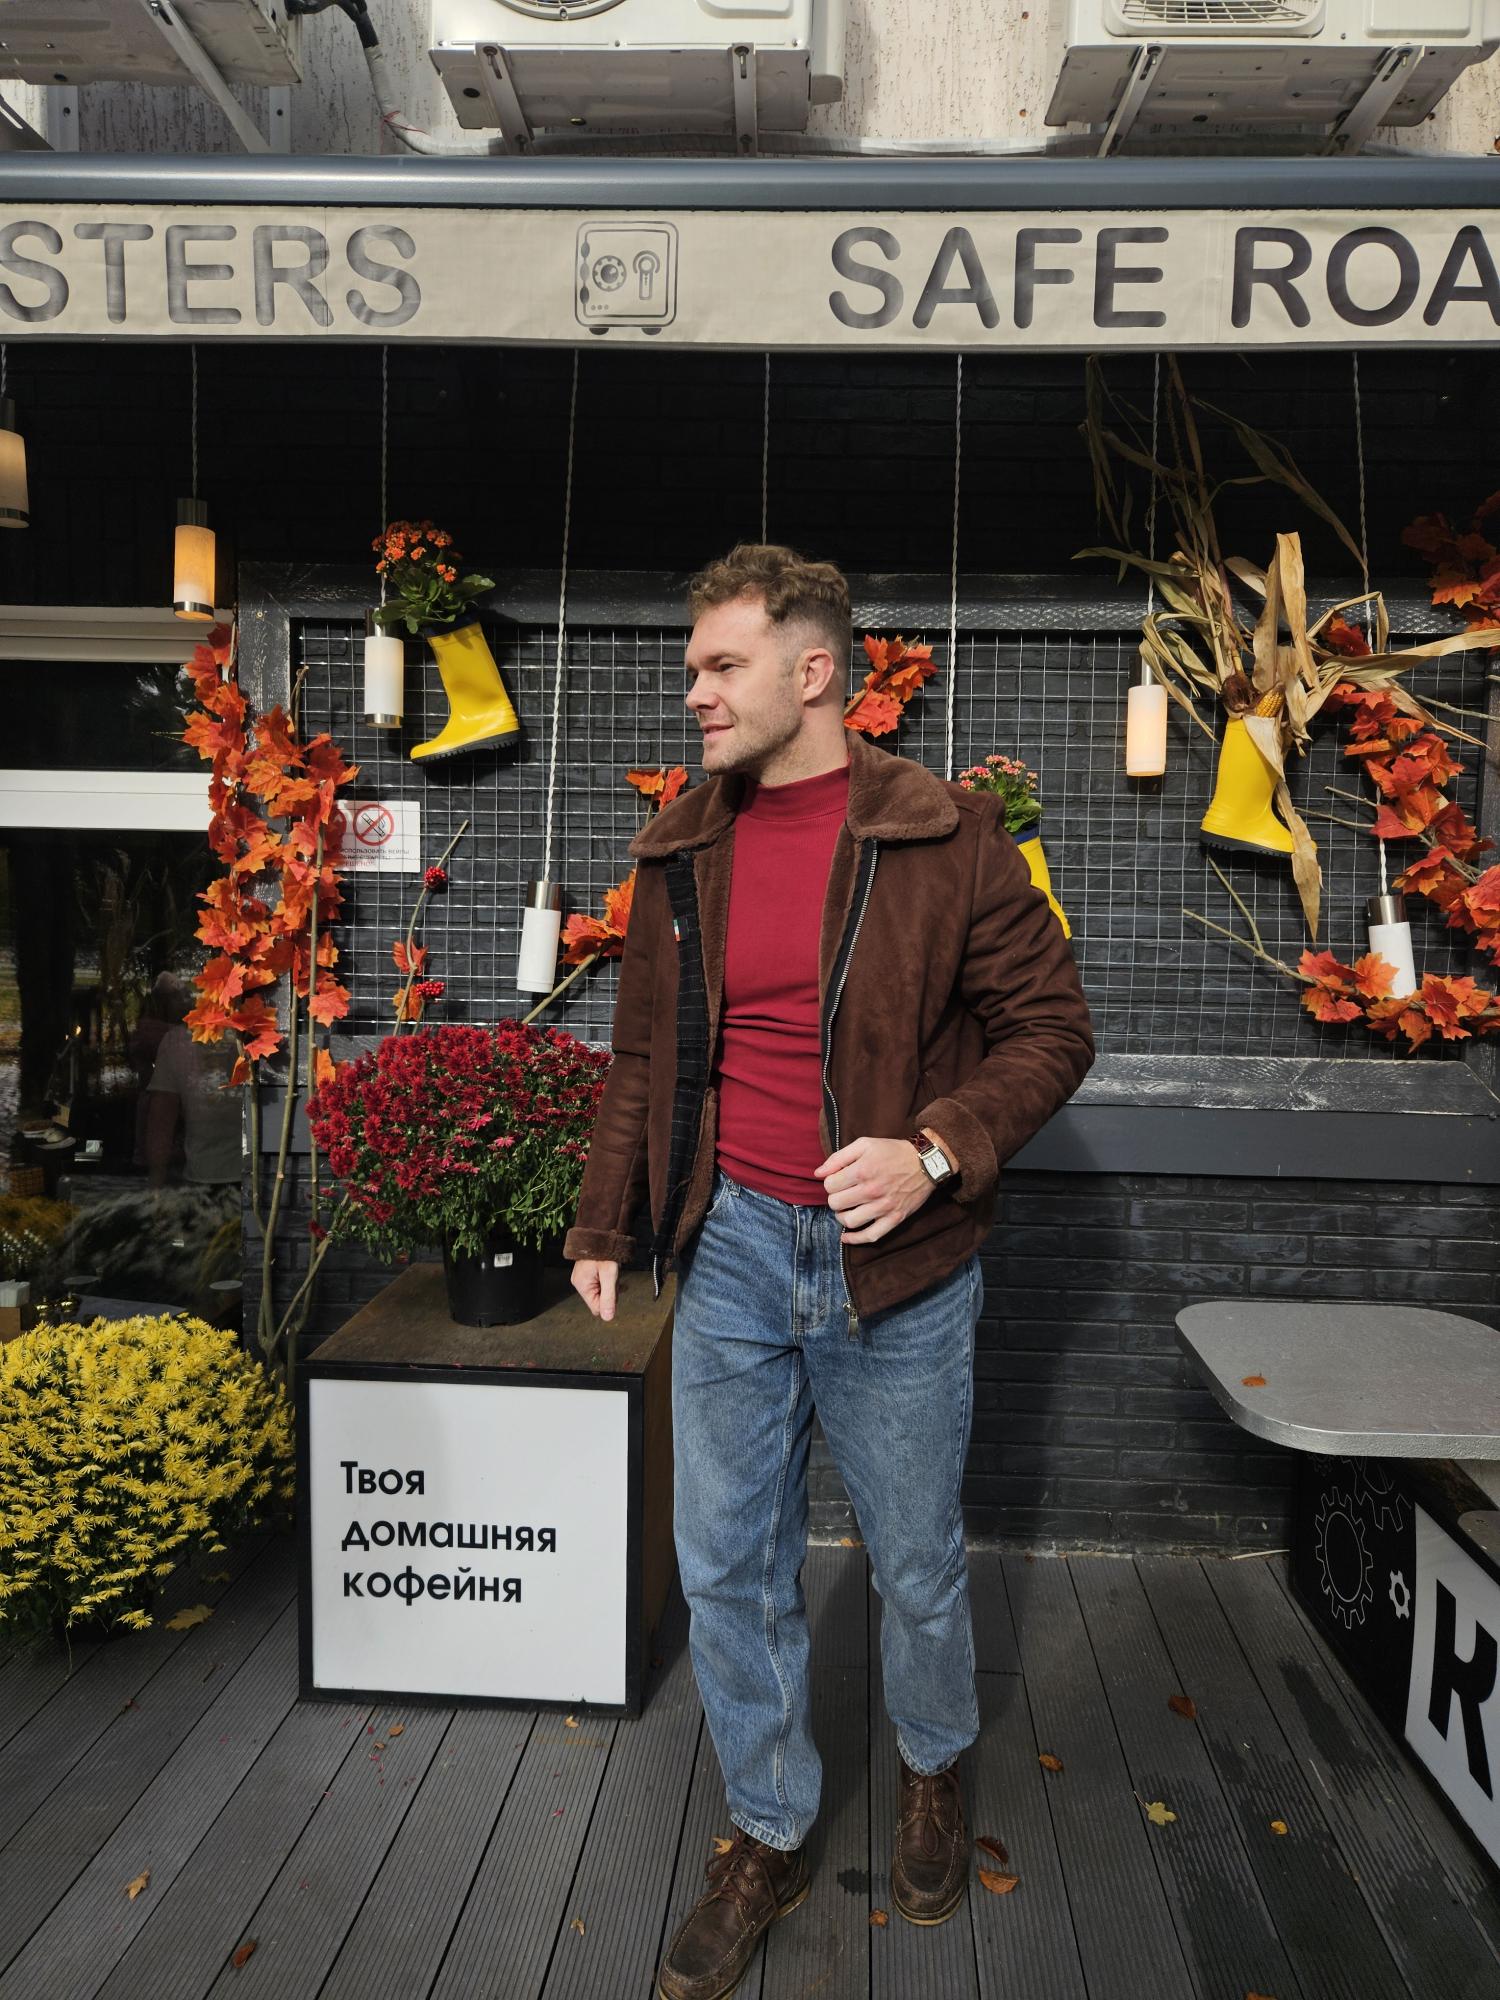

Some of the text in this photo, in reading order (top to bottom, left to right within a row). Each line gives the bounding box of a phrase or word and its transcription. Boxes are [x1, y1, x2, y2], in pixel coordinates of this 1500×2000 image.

[0, 220, 422, 328] STERS
[828, 223, 1500, 329] SAFE ROA
[340, 1460, 425, 1495] Твоя
[341, 1520, 557, 1552] домашняя
[343, 1565, 522, 1606] кофейня
